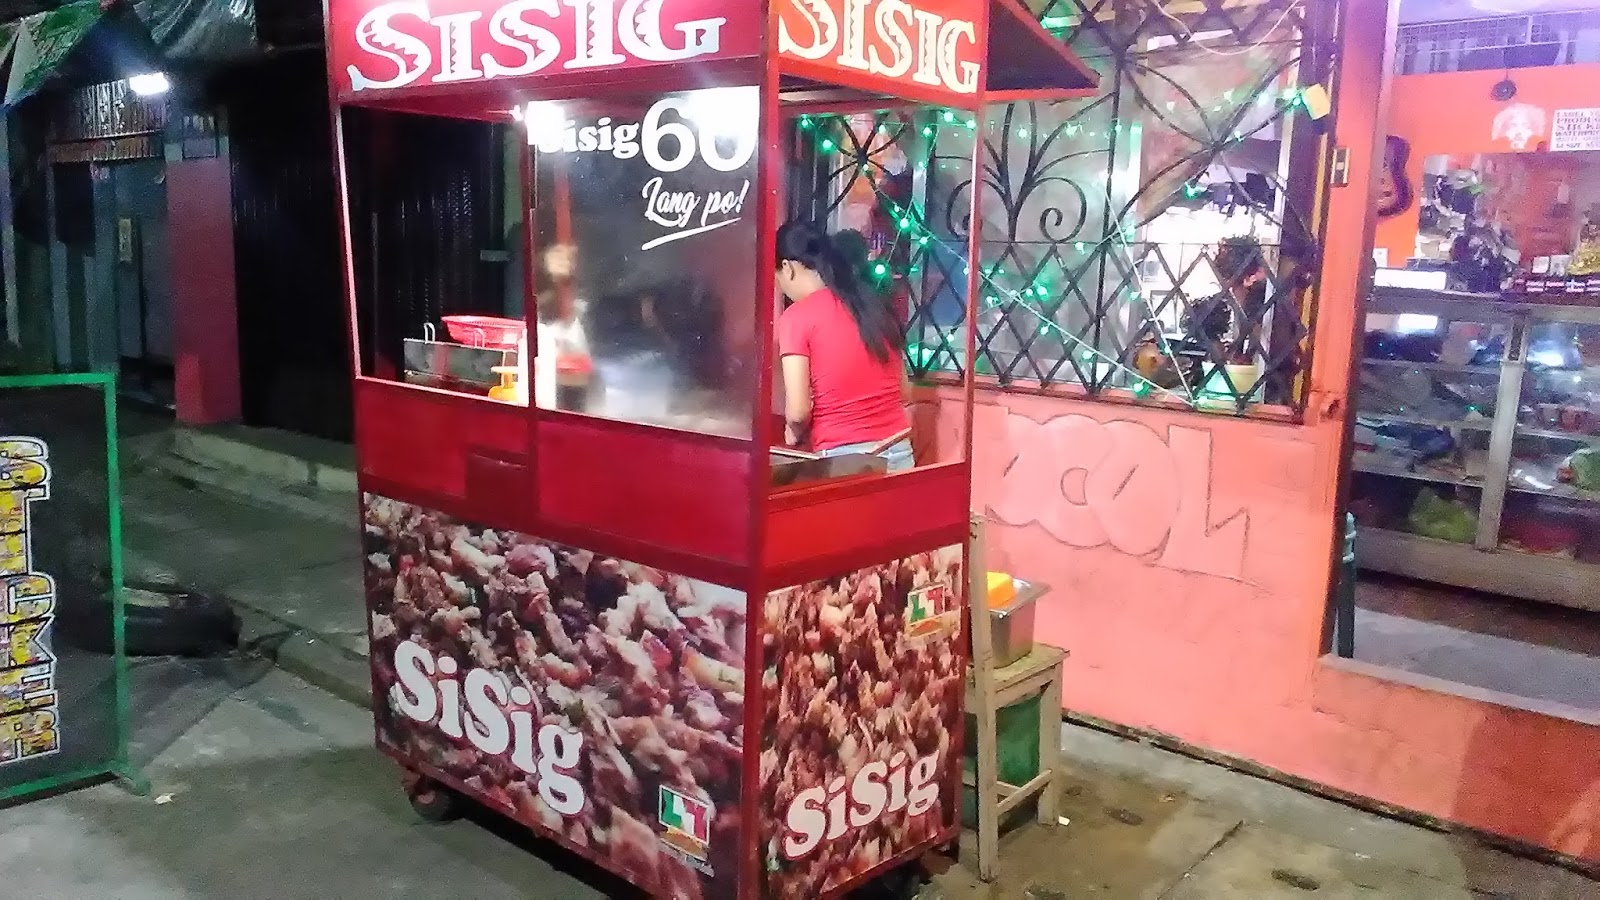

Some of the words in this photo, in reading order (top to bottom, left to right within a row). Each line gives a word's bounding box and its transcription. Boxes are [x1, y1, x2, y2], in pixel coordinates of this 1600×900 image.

[347, 0, 727, 91] SISIG
[778, 0, 980, 93] SISIG
[641, 97, 757, 172] 60
[642, 176, 702, 228] Lang
[701, 179, 750, 227] po!
